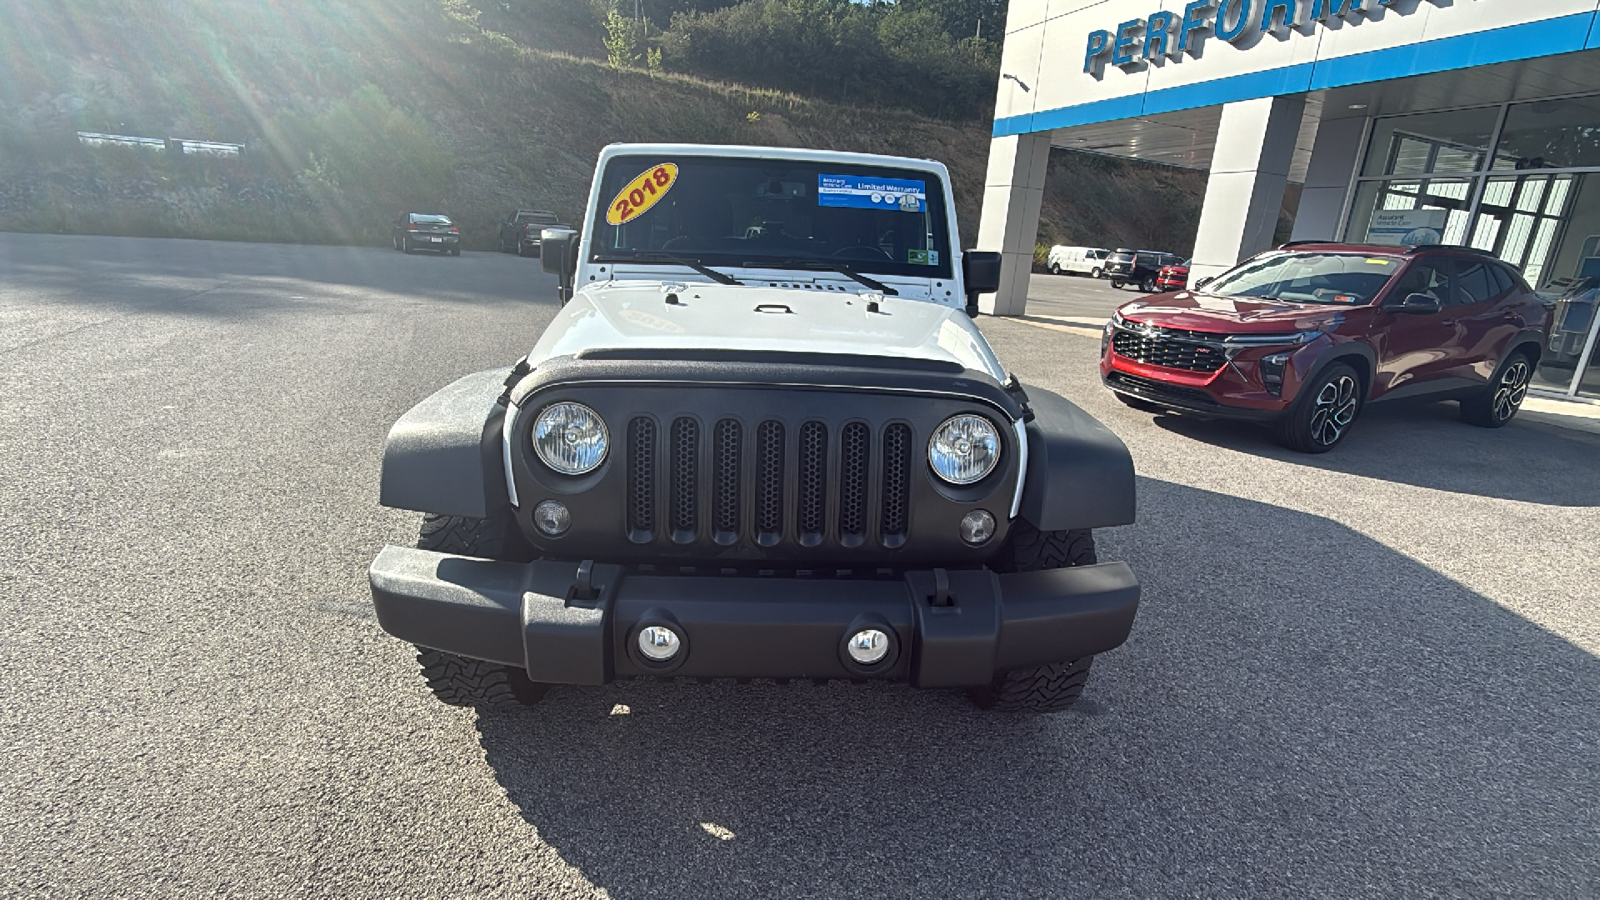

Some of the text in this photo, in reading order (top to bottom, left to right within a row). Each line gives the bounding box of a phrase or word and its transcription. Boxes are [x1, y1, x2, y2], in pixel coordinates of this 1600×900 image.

[1083, 0, 1398, 74] PERFOR
[615, 167, 671, 221] 2018
[857, 183, 885, 191] Limited
[886, 186, 920, 194] Warranty
